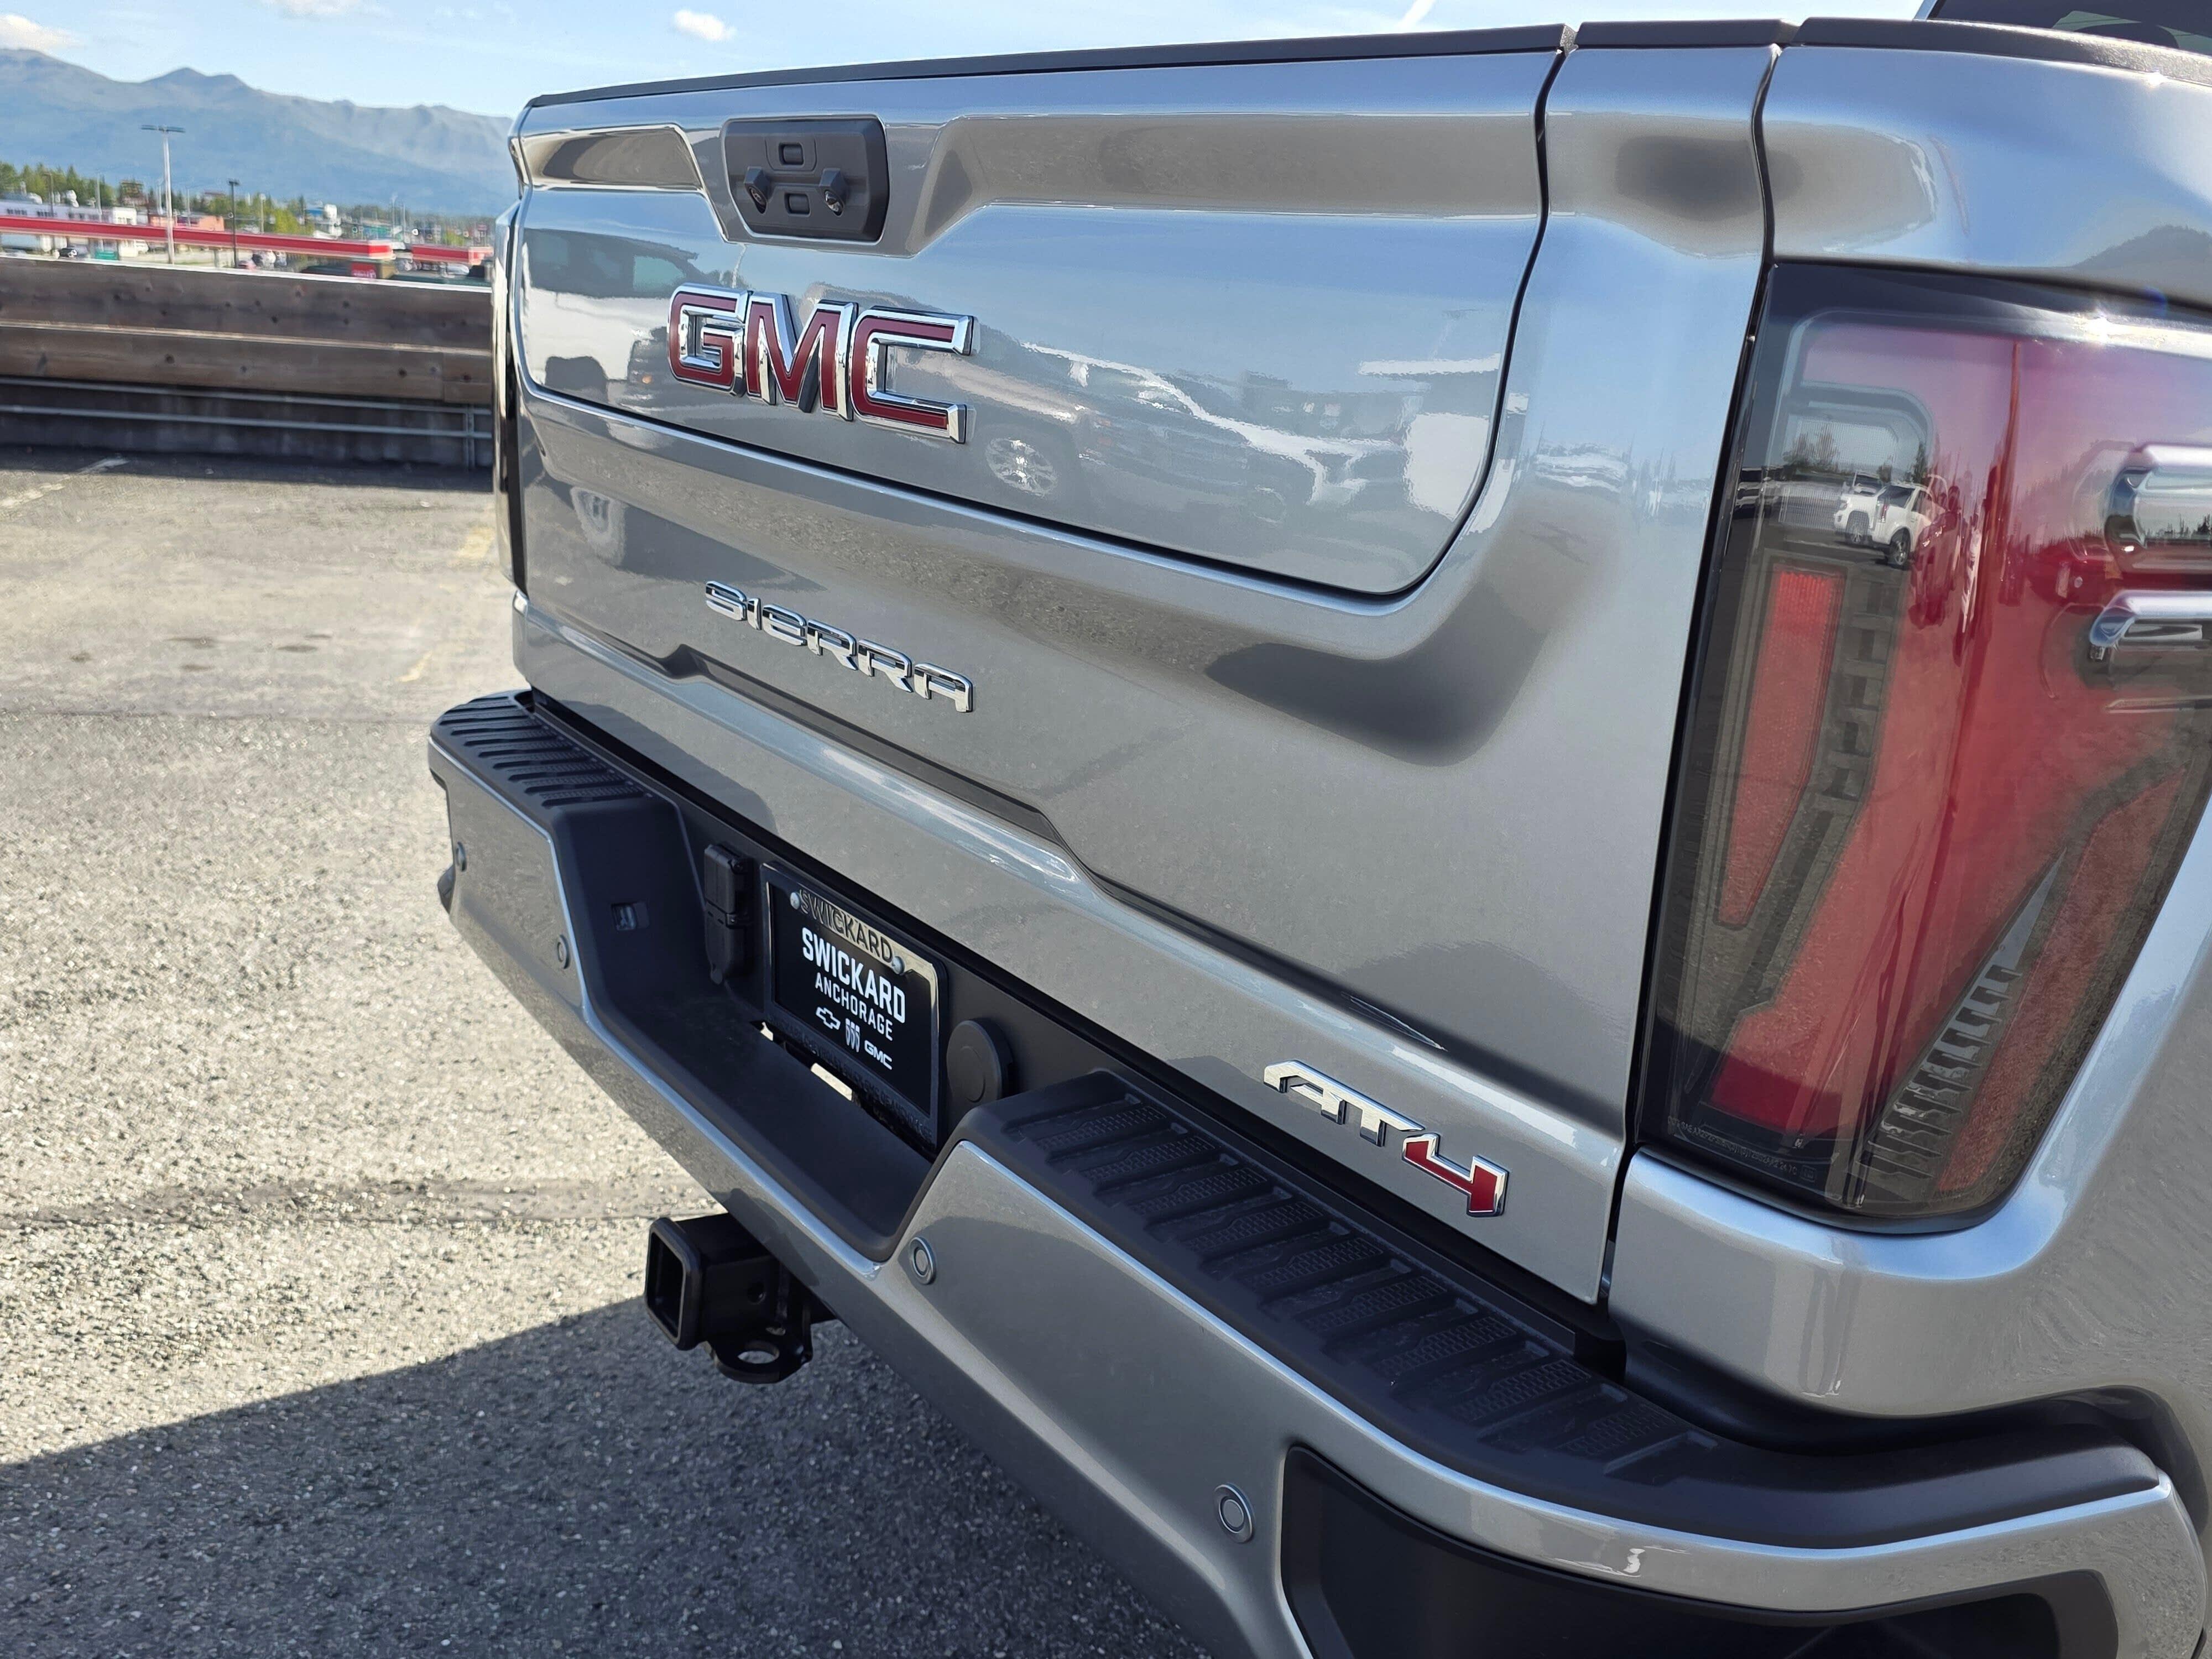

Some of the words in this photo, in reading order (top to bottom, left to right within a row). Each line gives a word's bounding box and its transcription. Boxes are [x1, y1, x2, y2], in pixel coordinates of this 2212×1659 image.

[667, 283, 975, 444] GMC
[705, 581, 973, 713] SIERRA
[801, 890, 894, 963] SWICKARD
[802, 927, 905, 1024] SWICKARD
[815, 972, 893, 1041] ANCHORAGE
[864, 1040, 893, 1070] GMC
[1263, 1059, 1509, 1217] AT4
